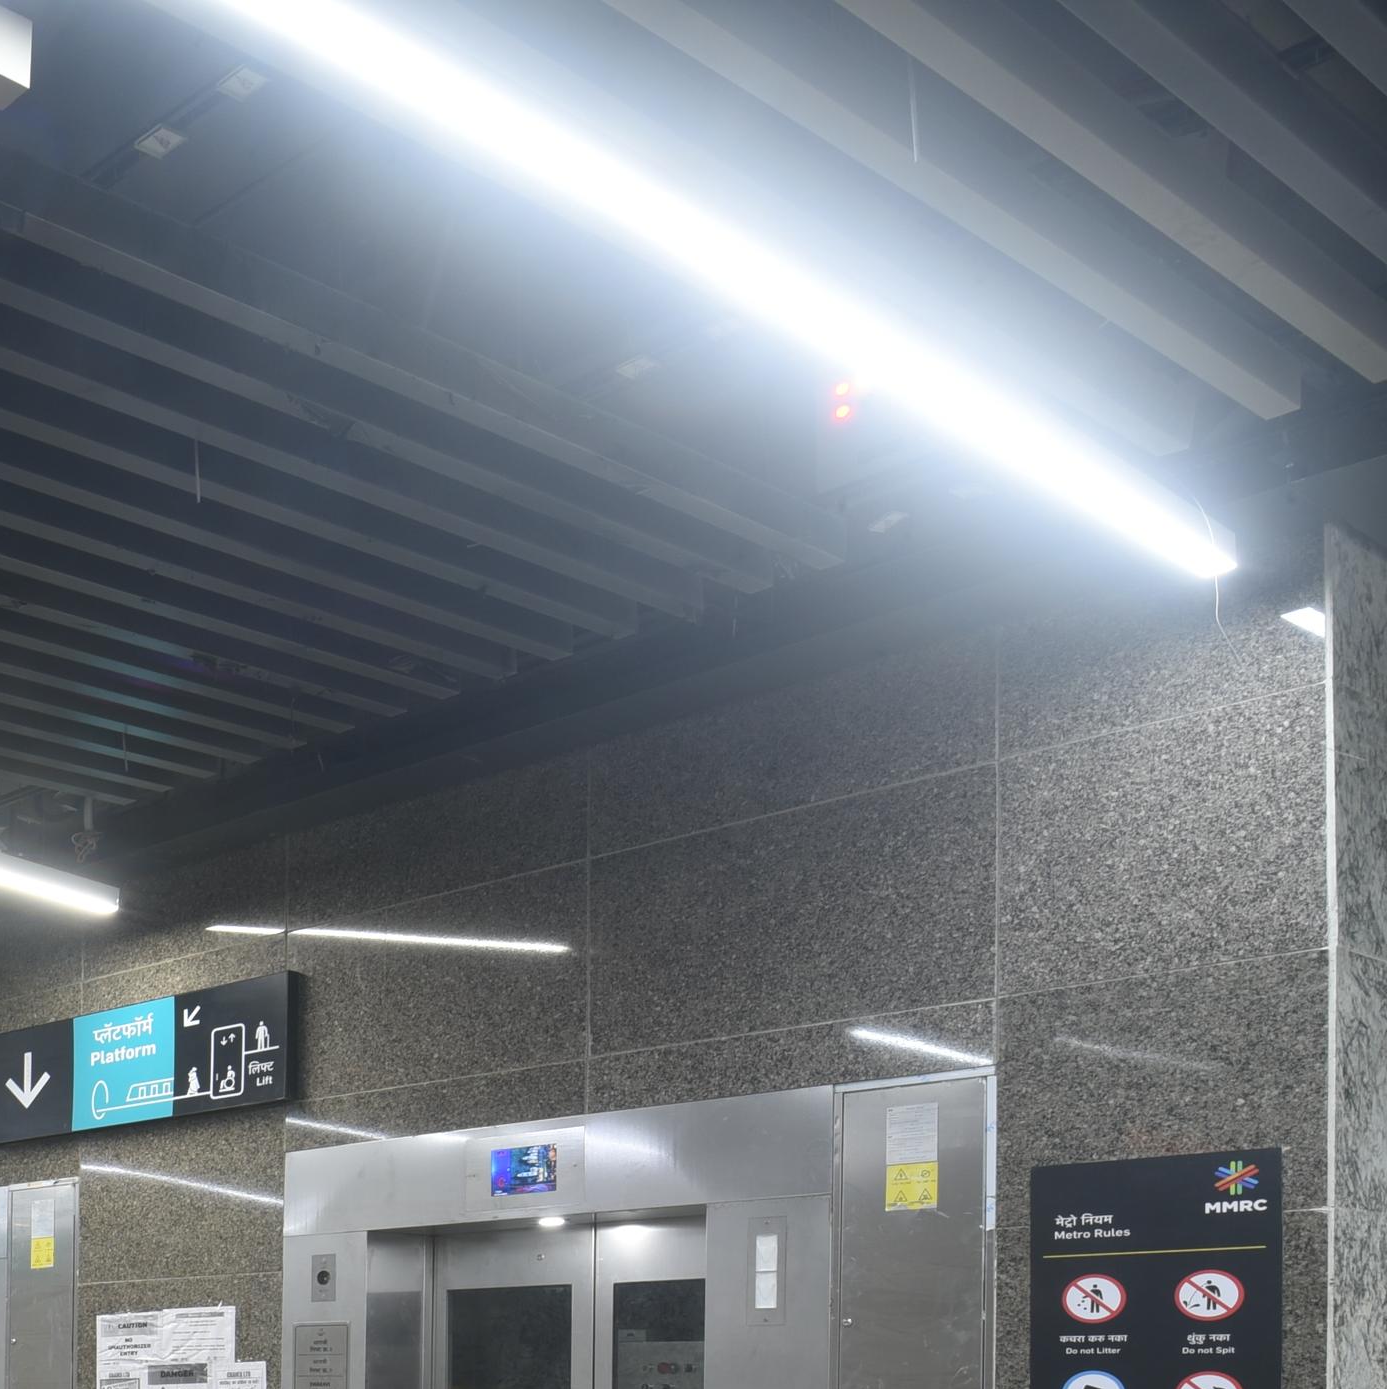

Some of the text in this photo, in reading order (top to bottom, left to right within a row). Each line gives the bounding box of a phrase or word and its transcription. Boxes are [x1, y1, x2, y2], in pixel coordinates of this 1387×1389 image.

[93, 1012, 154, 1044] प्लॅटफॉर्म
[90, 1043, 156, 1067] Platform
[248, 1060, 275, 1076] लिफ्ट
[256, 1076, 273, 1087] Lift
[1204, 1198, 1268, 1214] MMRC
[1054, 1212, 1114, 1228] मेट्रो नियम
[1054, 1227, 1131, 1240] Metro Rules
[1107, 1334, 1128, 1342] नका
[1208, 1333, 1231, 1342] नका
[1215, 1346, 1235, 1355] Spit
